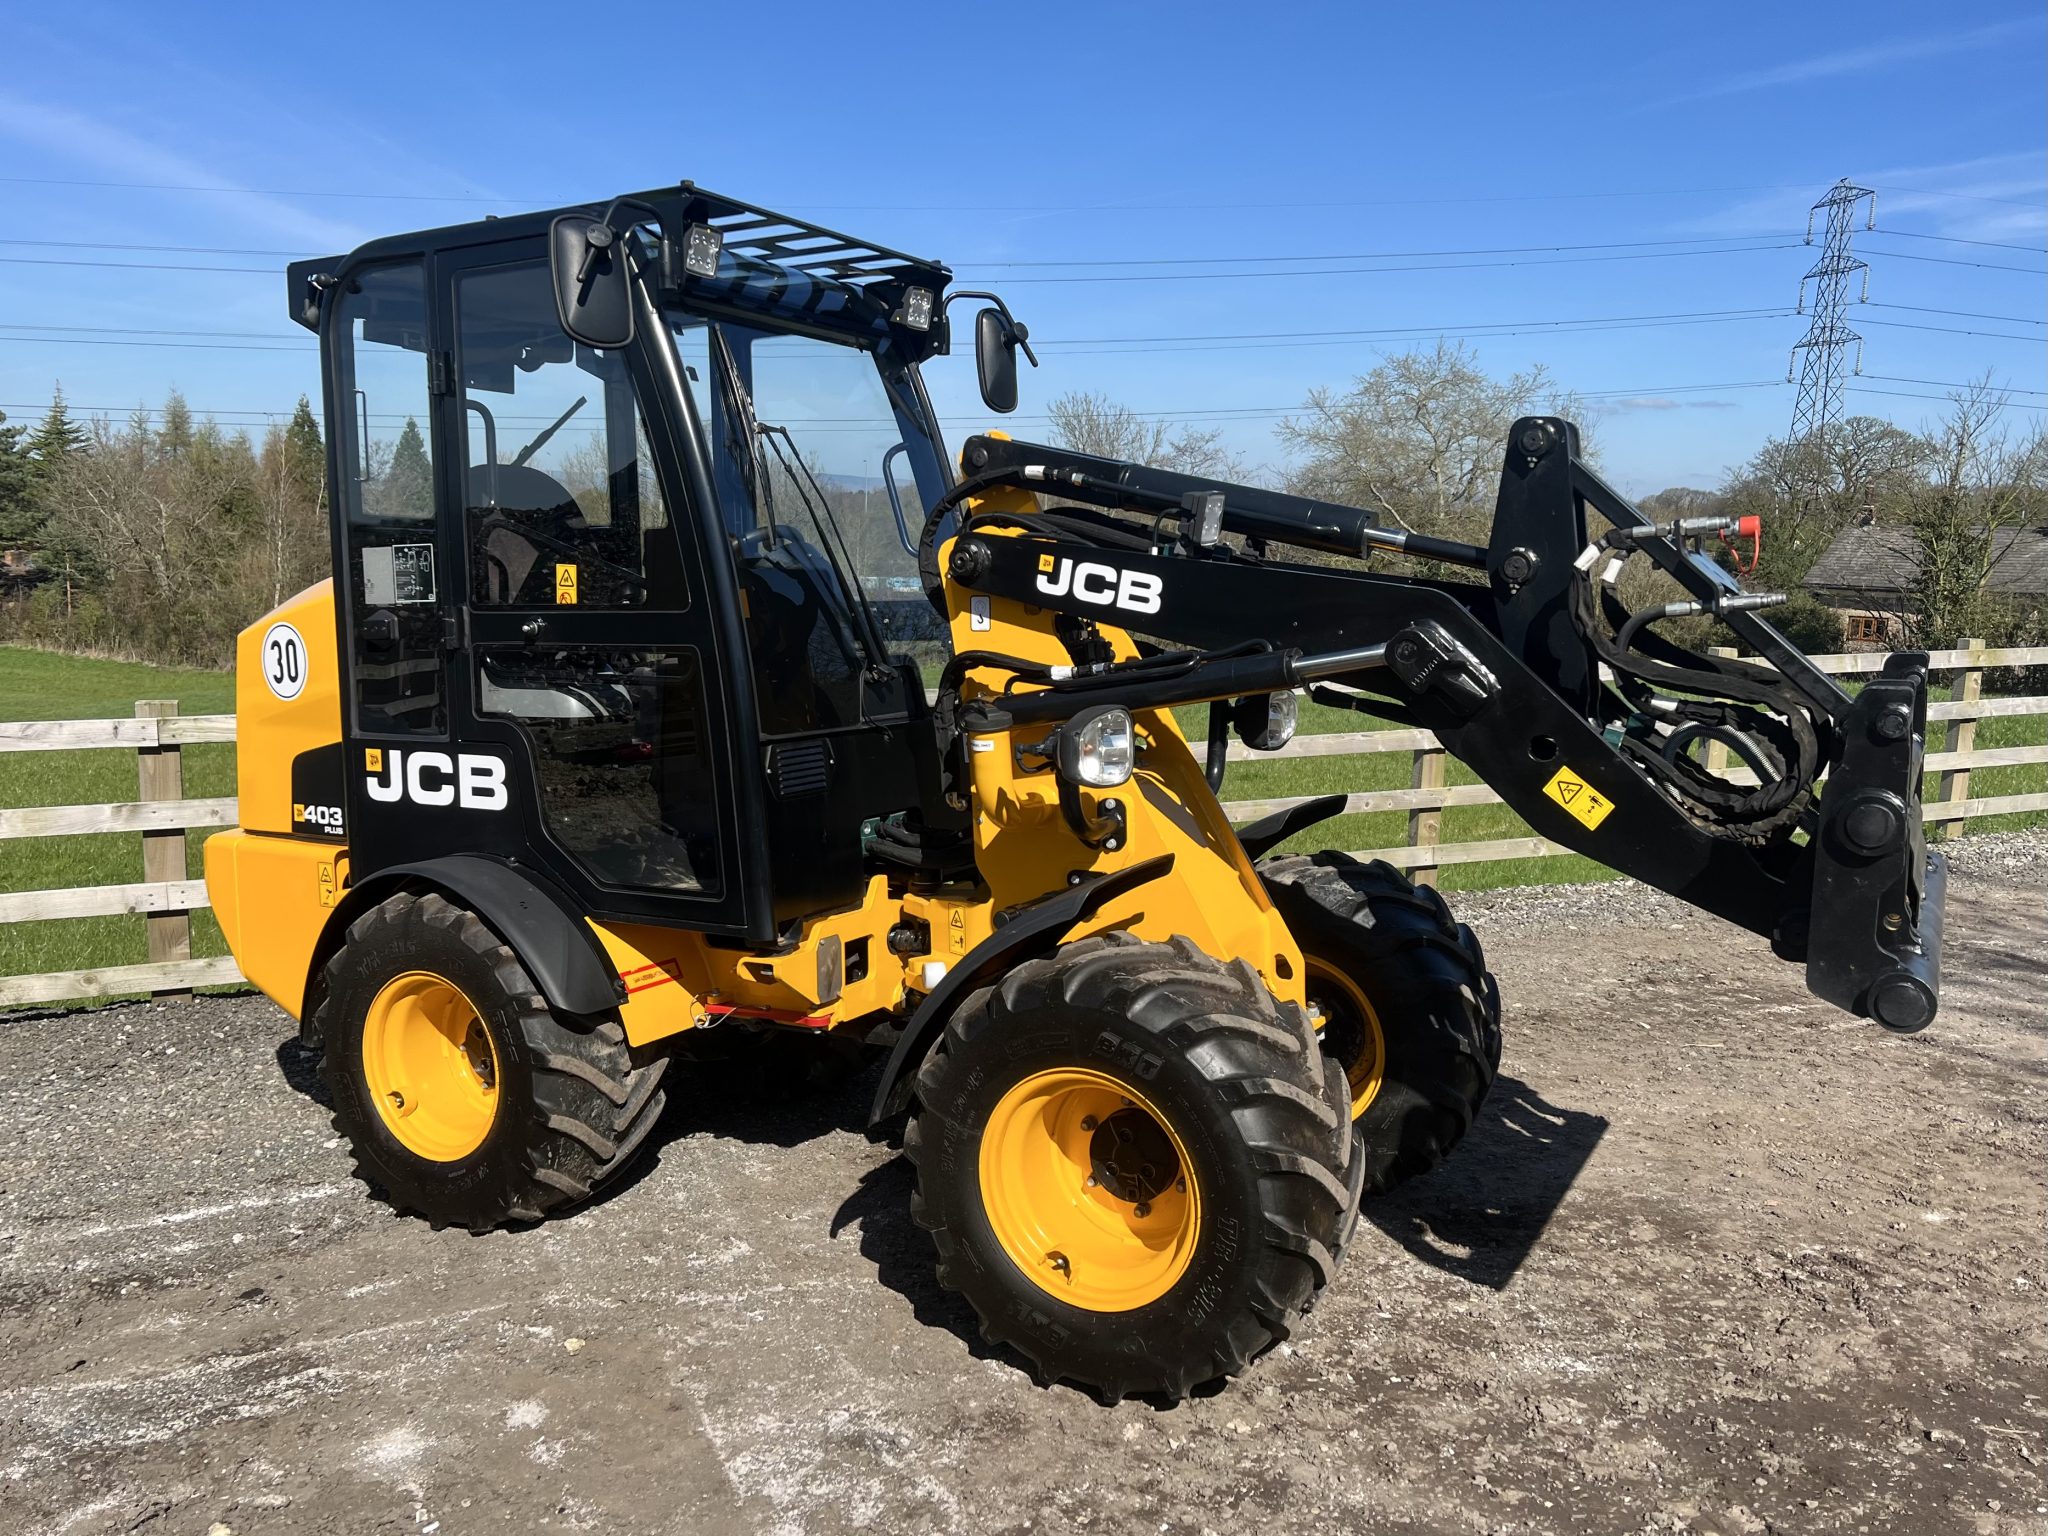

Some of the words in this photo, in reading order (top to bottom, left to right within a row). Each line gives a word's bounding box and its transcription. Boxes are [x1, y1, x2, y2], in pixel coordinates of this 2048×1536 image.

[1036, 557, 1163, 614] JCB
[270, 638, 299, 685] 30
[366, 749, 508, 811] JCB
[304, 805, 343, 826] 403
[324, 826, 344, 835] PLUS
[1093, 1031, 1163, 1082] BKT
